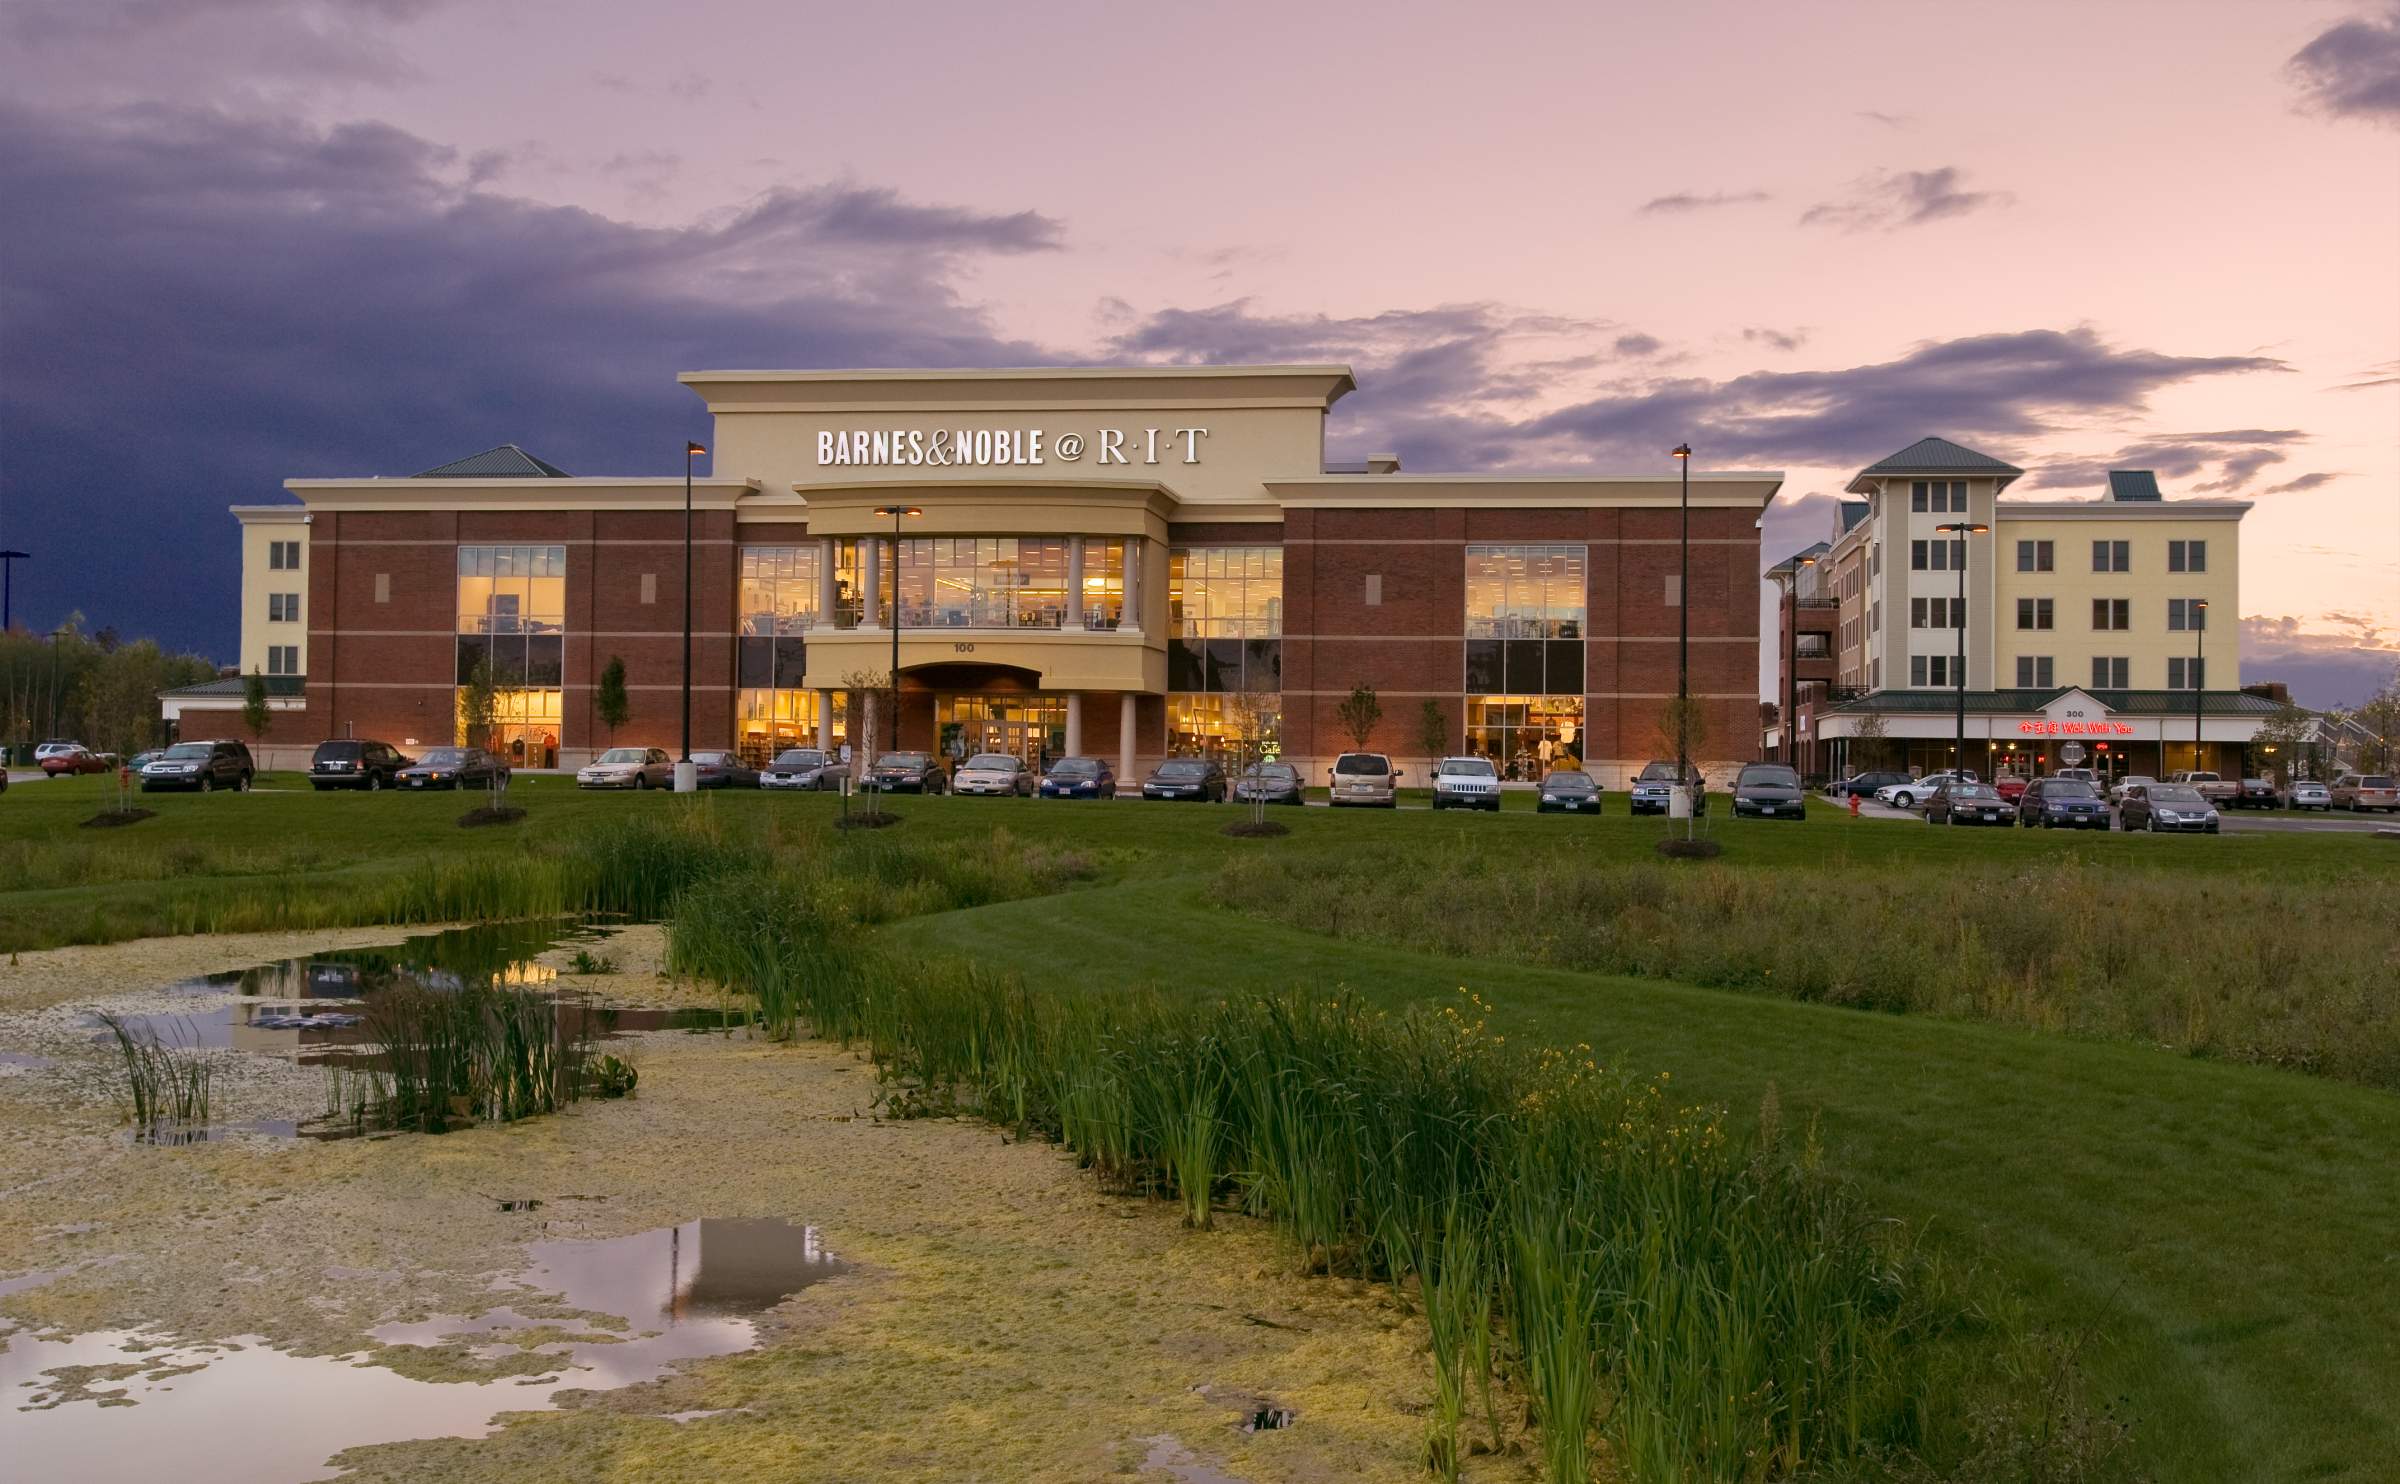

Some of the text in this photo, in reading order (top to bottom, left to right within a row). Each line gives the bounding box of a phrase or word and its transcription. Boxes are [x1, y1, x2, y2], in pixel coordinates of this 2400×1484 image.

[817, 429, 1044, 466] BARNES&NOBLE
[1054, 432, 1085, 461] @
[954, 643, 975, 653] 100
[2066, 710, 2084, 718] 300
[2087, 721, 2111, 734] With
[2113, 721, 2133, 735] You
